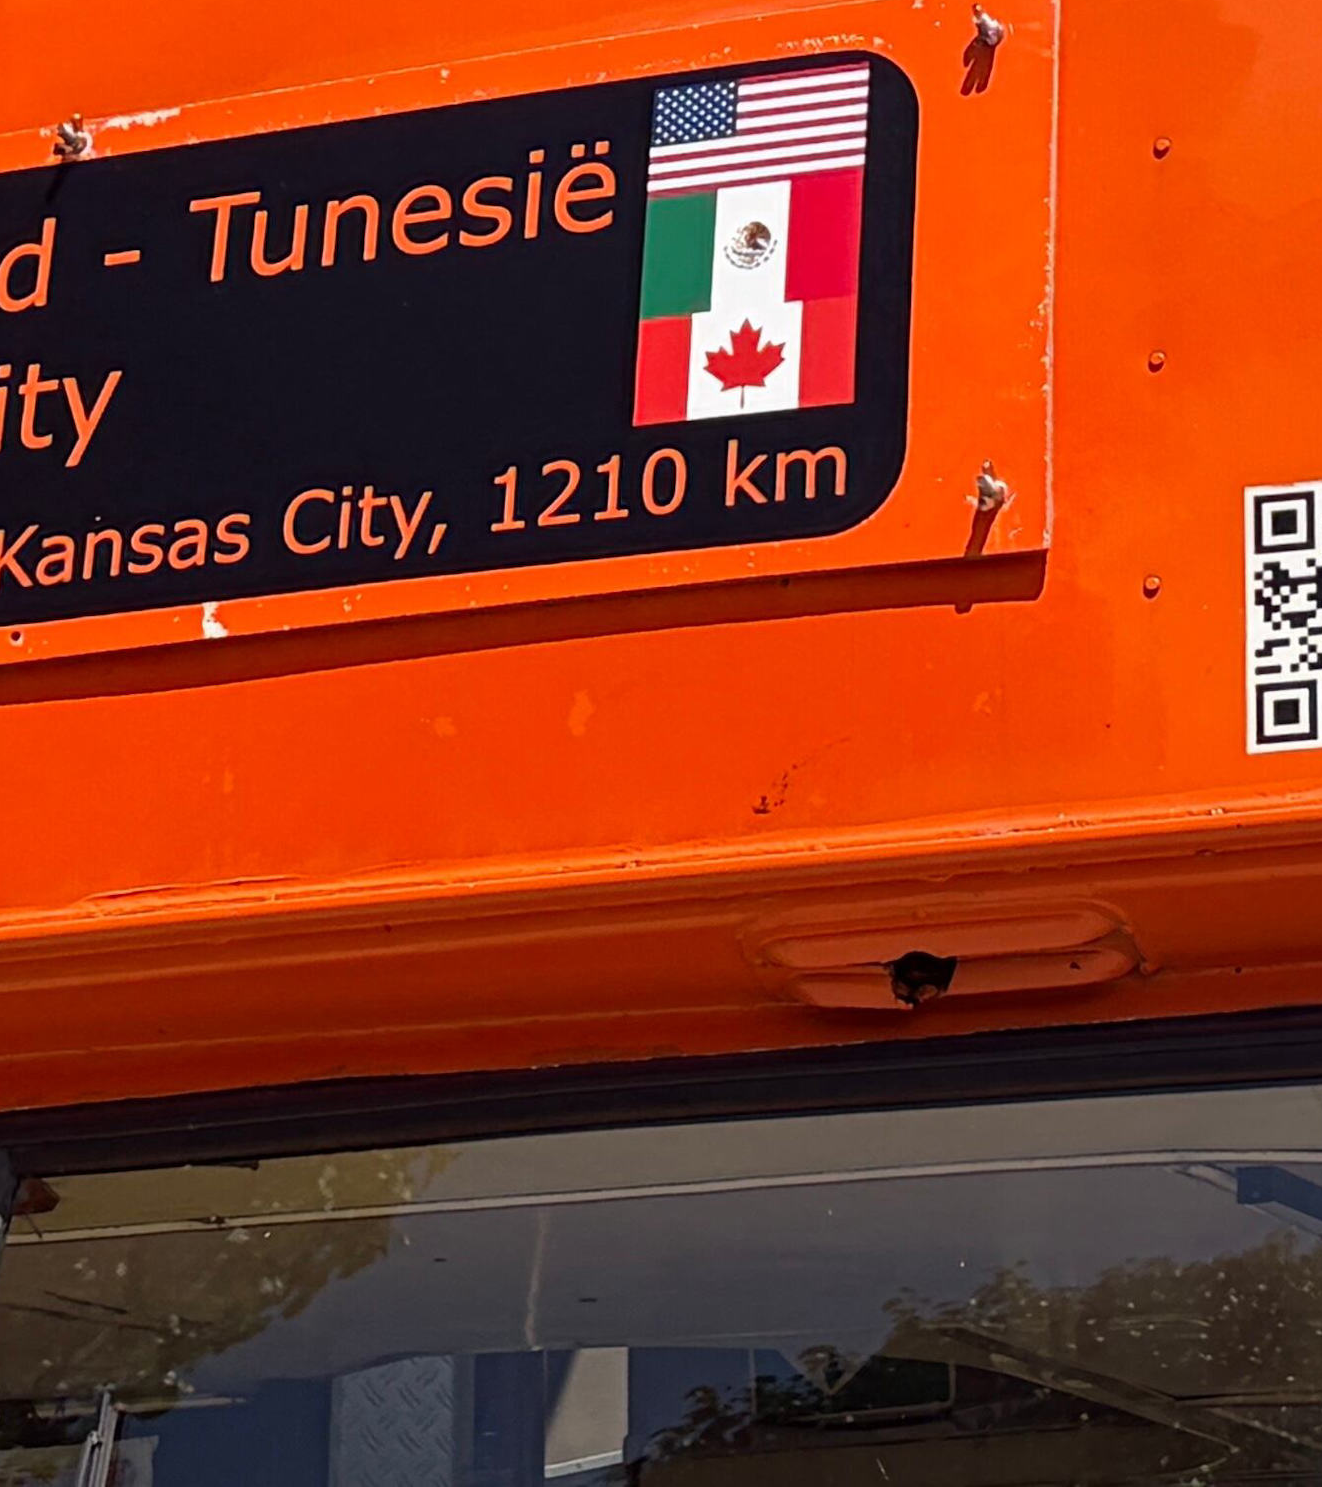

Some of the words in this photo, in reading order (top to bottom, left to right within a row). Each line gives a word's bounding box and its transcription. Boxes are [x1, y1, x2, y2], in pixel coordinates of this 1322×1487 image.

[103, 248, 142, 267] -
[189, 140, 616, 282] Tunesië
[282, 485, 448, 560] City,
[489, 448, 687, 533] 1210
[724, 438, 847, 507] km
